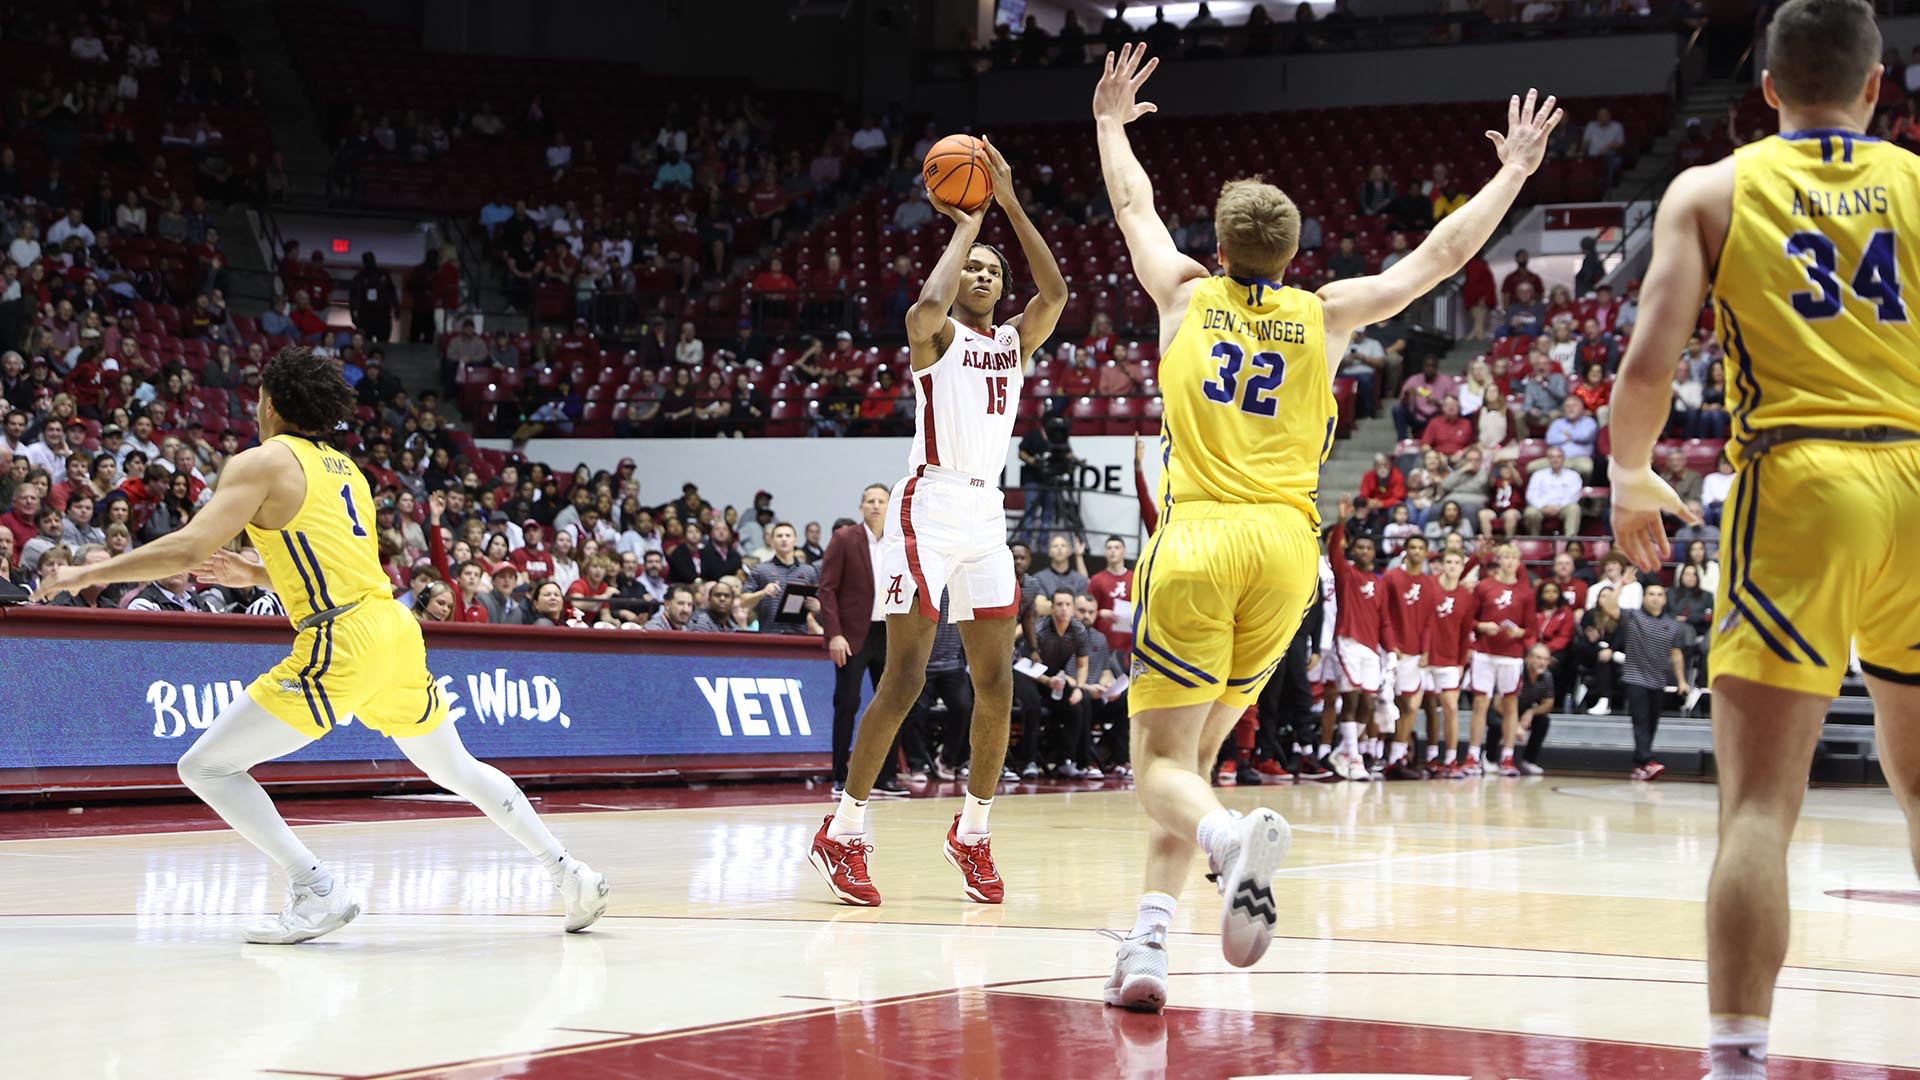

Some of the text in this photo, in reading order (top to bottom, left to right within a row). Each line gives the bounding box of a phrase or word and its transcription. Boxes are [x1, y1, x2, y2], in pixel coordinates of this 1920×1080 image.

[1791, 186, 1888, 216] ARIANS
[1786, 230, 1908, 321] 34
[962, 349, 1018, 371] ALAAMA
[1203, 341, 1285, 417] 32
[985, 376, 1008, 415] 15
[340, 484, 367, 536] 1
[466, 668, 571, 729] WILD.
[693, 676, 812, 737] YETI
